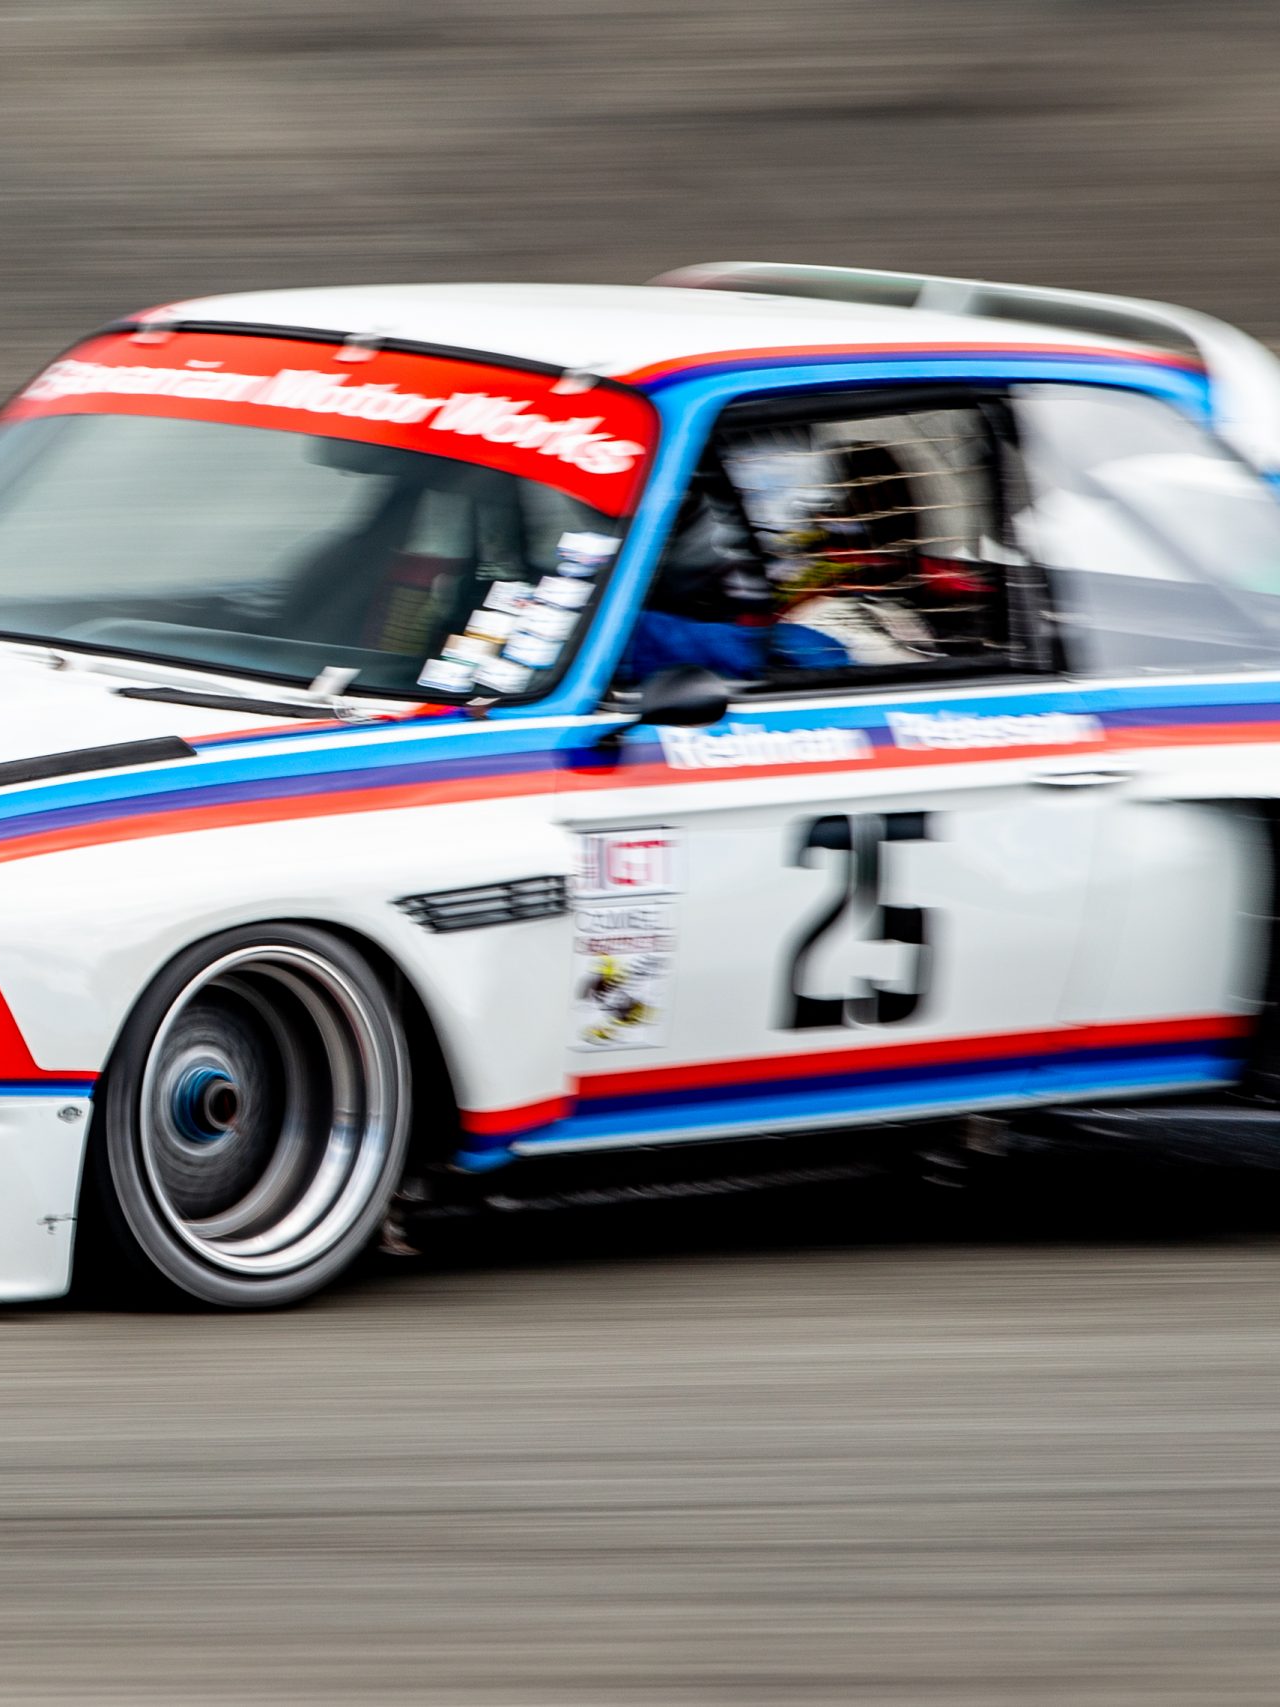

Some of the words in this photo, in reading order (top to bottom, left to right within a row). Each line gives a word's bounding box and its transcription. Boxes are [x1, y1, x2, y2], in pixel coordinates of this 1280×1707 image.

[266, 368, 446, 423] Motor
[429, 392, 645, 474] Works
[776, 810, 948, 1032] 25
